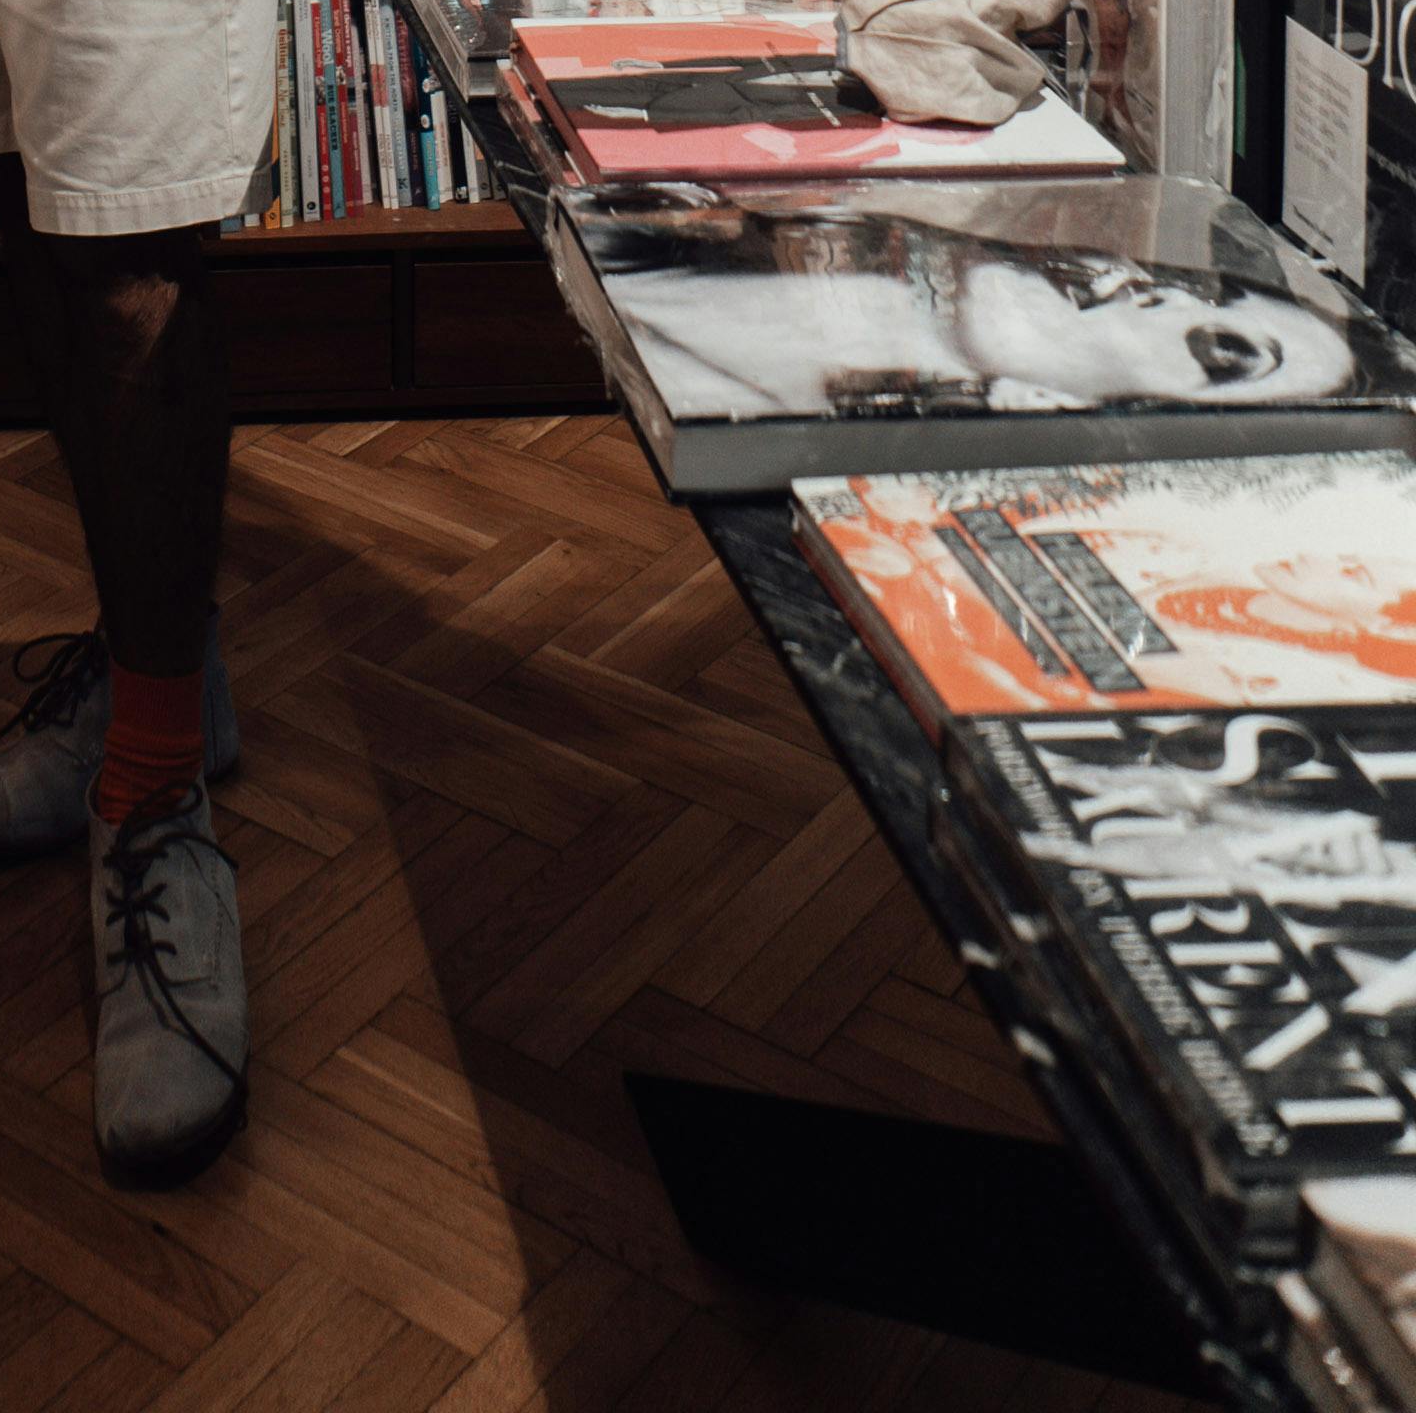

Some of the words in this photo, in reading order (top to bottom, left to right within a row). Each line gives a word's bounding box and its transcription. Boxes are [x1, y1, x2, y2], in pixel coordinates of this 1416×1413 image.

[343, 13, 352, 38] throws
[279, 28, 288, 70] Quilting
[320, 28, 334, 66] Wool
[384, 18, 394, 51] KNITTING
[390, 88, 399, 112] NORTH
